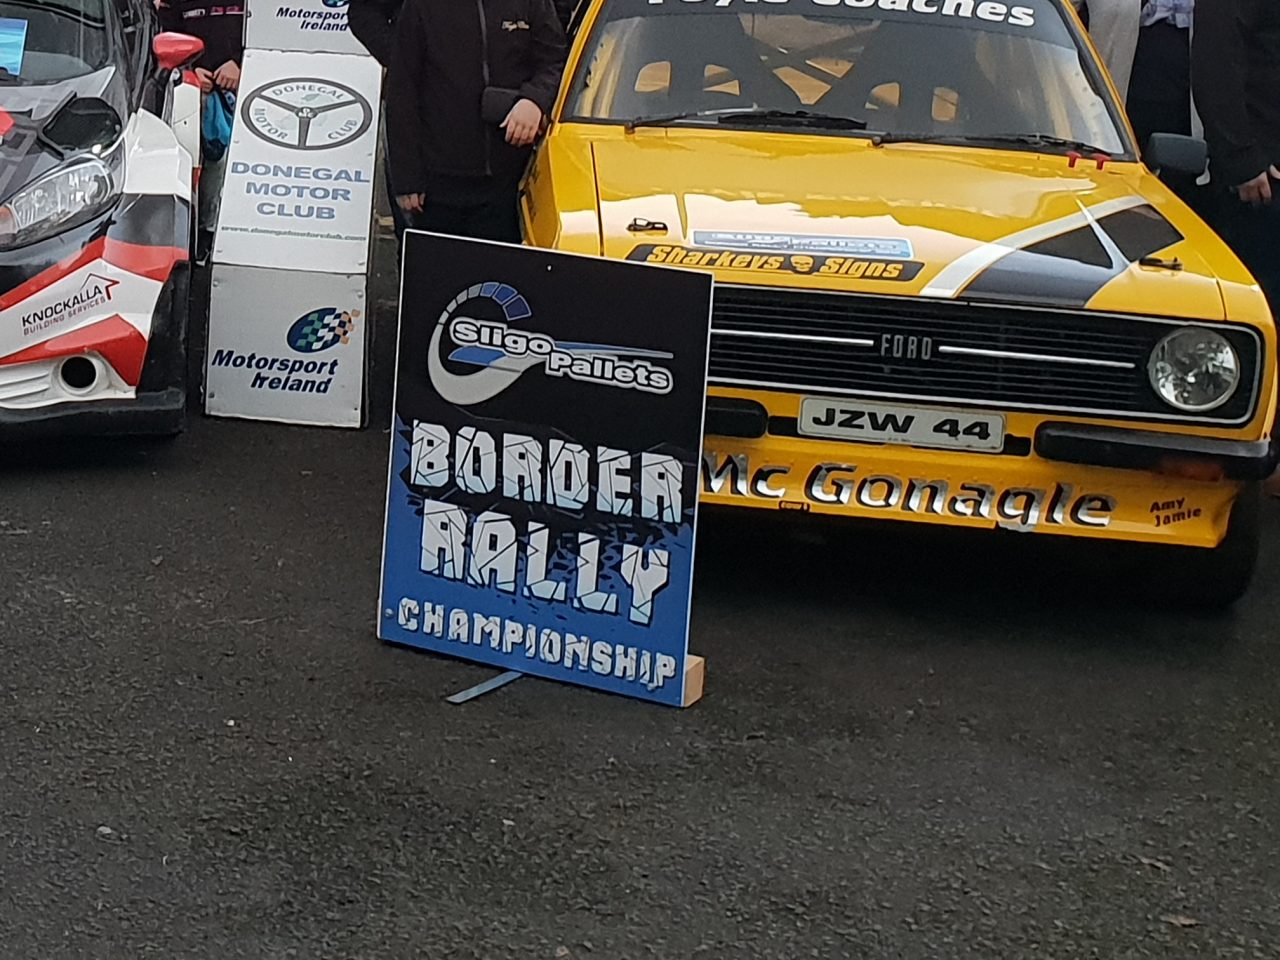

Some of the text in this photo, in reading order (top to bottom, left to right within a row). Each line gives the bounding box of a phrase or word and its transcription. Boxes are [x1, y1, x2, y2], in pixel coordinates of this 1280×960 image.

[276, 7, 348, 21] Motorspor
[301, 17, 349, 32] Ireland
[272, 85, 345, 100] DONEGAL
[254, 107, 289, 140] MOTOR
[328, 119, 357, 140] CLUB
[231, 162, 370, 183] DONEGAL
[246, 182, 351, 201] MOTOR
[257, 202, 335, 219] CLUB
[646, 245, 904, 279] Sharkeys Signs
[22, 285, 103, 327] KNOCKALLA
[23, 296, 106, 336] BUILDING SERVICES
[450, 318, 672, 392] Sligo Pallets
[880, 334, 933, 360] FORD
[212, 349, 338, 375] Motorsport
[251, 372, 332, 394] Ireland
[812, 408, 991, 440] JZW 44
[410, 420, 683, 523] BORDER
[701, 450, 1117, 532] Mc Gonagle
[1150, 497, 1185, 513] Amy
[1155, 508, 1201, 527] Jamie
[420, 499, 669, 624] RALLY
[397, 597, 676, 690] CHAMPIONSHIP
